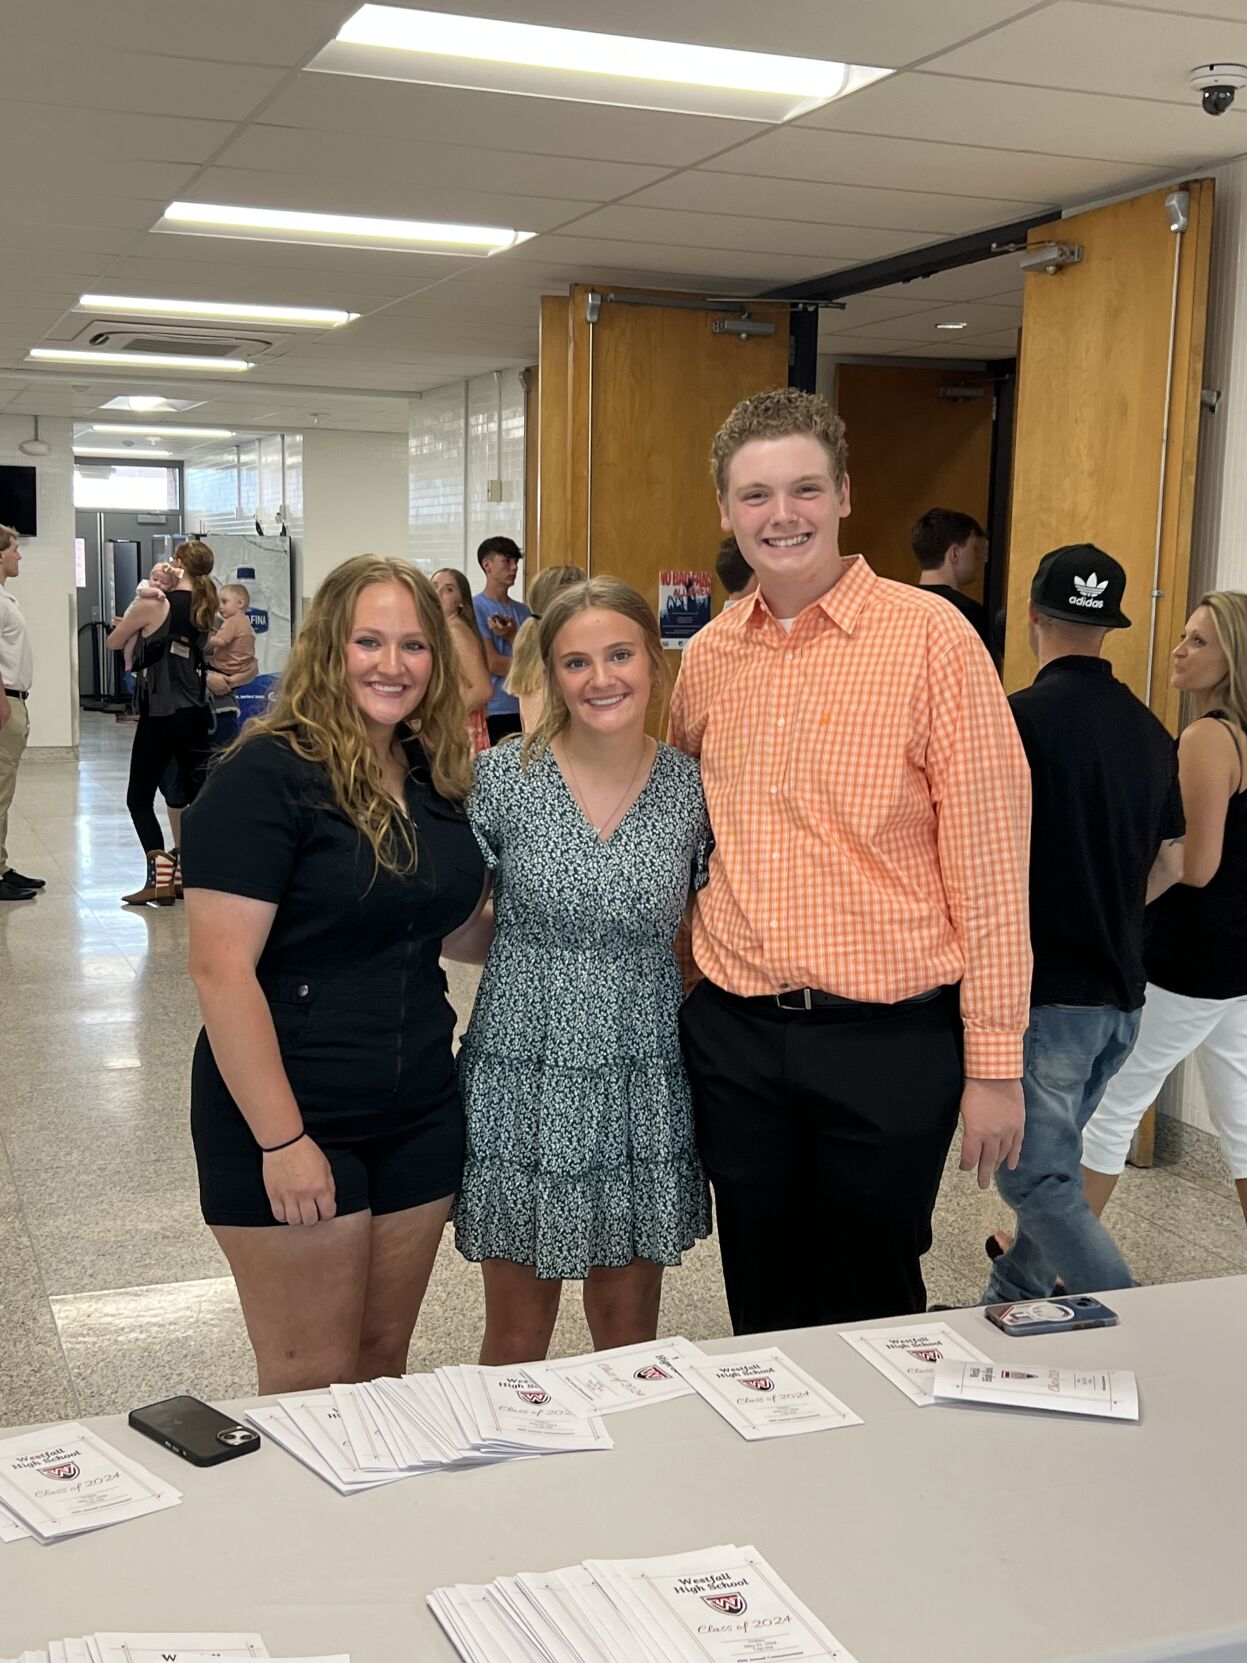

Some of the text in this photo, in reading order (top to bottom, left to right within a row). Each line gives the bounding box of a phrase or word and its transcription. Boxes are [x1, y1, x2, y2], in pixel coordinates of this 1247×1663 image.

[1069, 596, 1104, 609] adidas
[889, 1336, 929, 1345] Westfall
[911, 1340, 943, 1348] School
[716, 1367, 775, 1379] High School
[718, 1364, 761, 1374] Westfall
[736, 1390, 810, 1404] Class of 2024
[499, 1405, 528, 1414] Class
[12, 1450, 82, 1471] High School
[16, 1448, 65, 1463] Westfall
[34, 1471, 121, 1498] Class of 2024
[678, 1572, 732, 1586] Westfall
[674, 1578, 750, 1595] High School
[697, 1615, 792, 1634] Class of 2024
